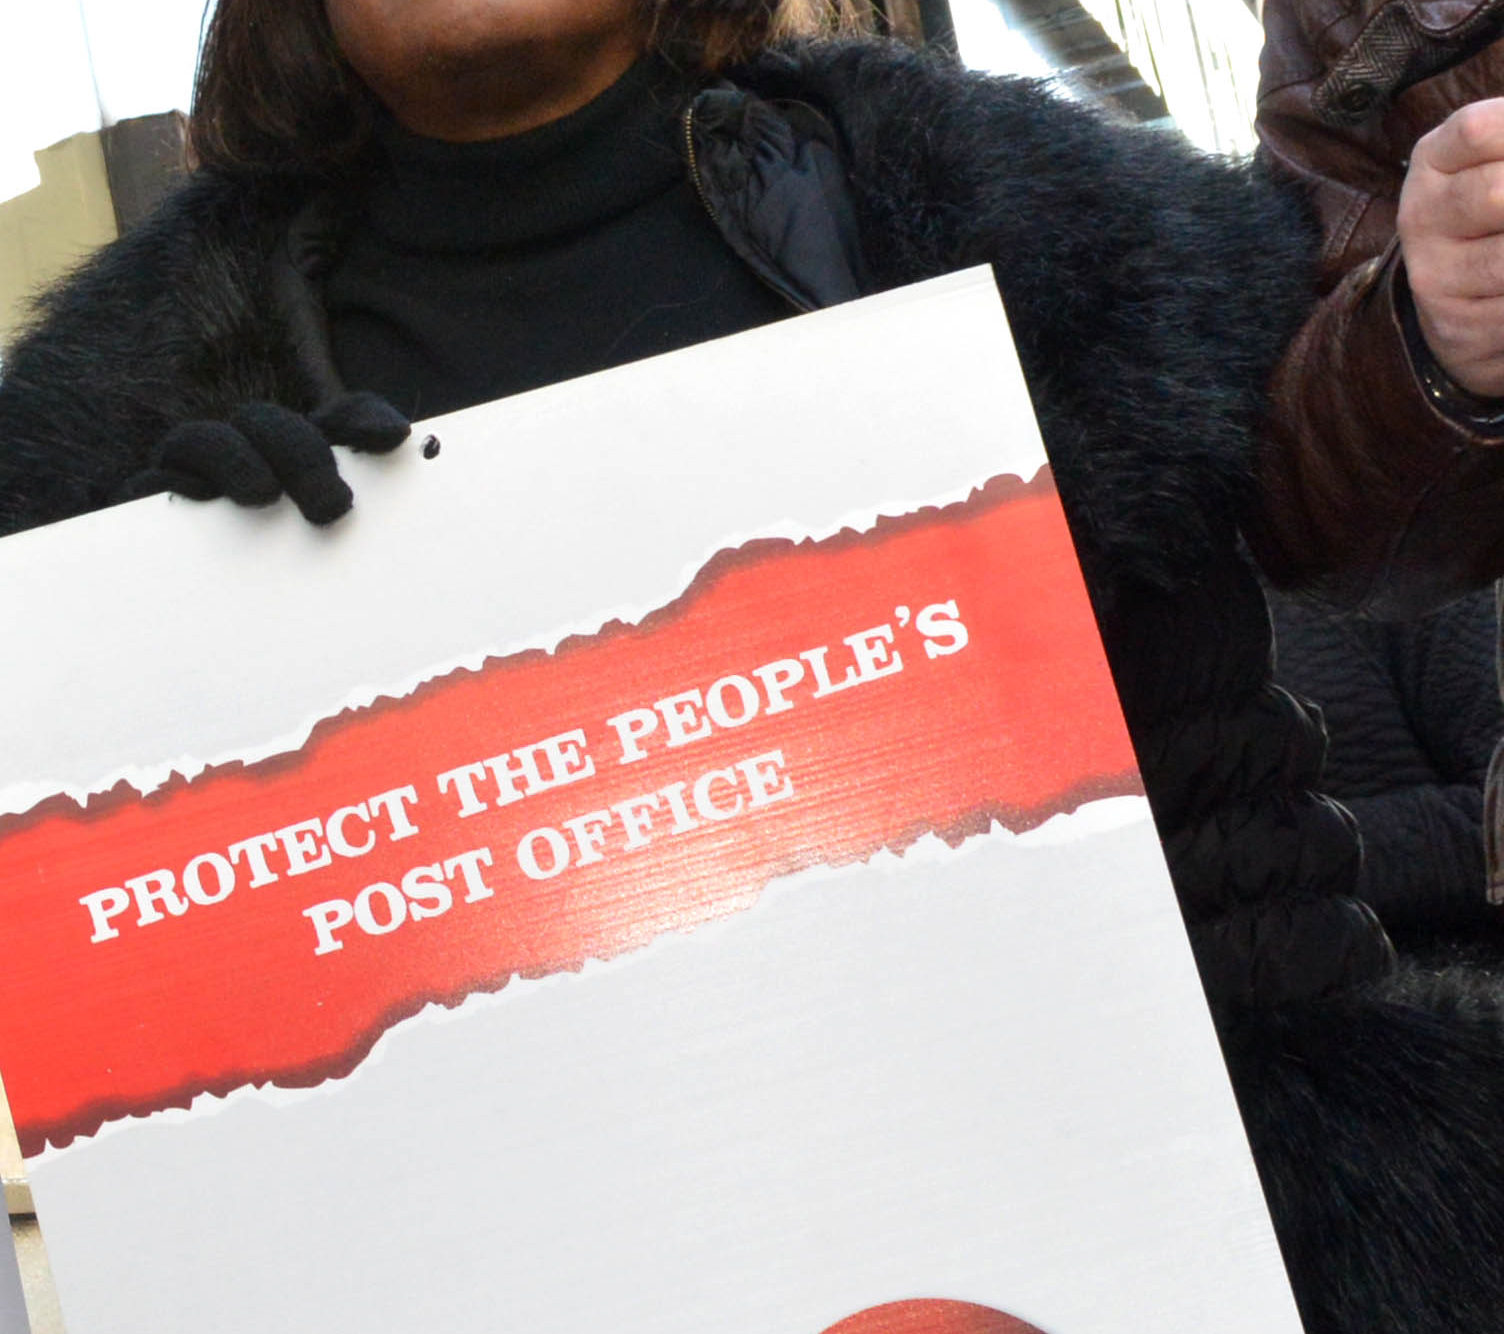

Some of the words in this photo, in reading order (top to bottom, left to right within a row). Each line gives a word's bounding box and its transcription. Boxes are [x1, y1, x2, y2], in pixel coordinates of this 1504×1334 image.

[80, 783, 420, 944] PROTECT
[437, 727, 595, 817] THE
[615, 598, 971, 759] PEOPLE'S
[303, 844, 496, 957] POST
[514, 748, 794, 881] OFFICE
